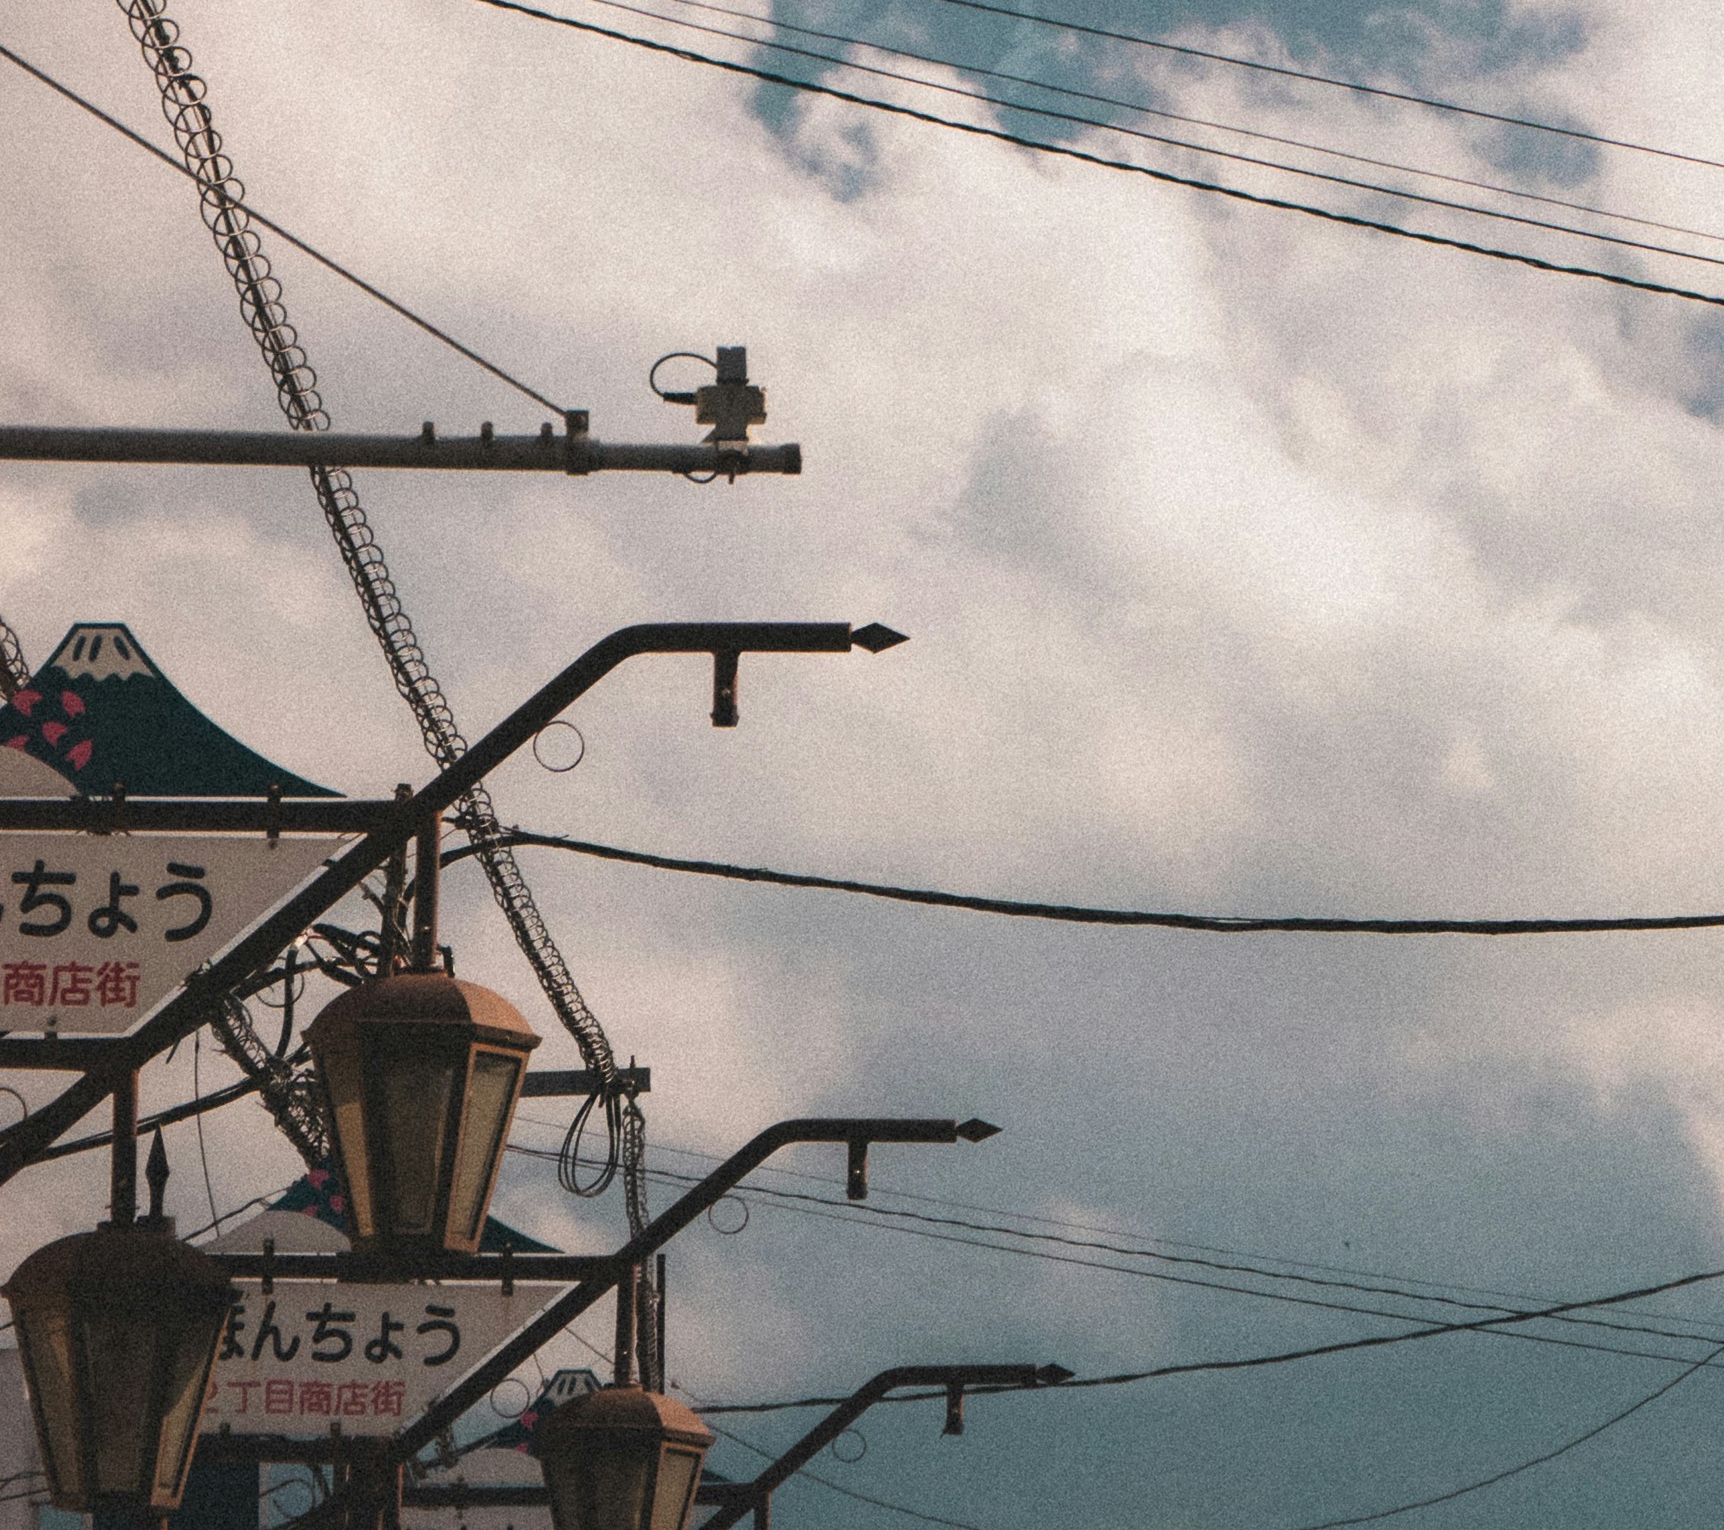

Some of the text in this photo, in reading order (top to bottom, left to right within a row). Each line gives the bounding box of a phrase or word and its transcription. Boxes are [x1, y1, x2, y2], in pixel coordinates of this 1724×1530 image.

[0, 860, 212, 942] ちょう
[3, 960, 142, 1008] 商店街
